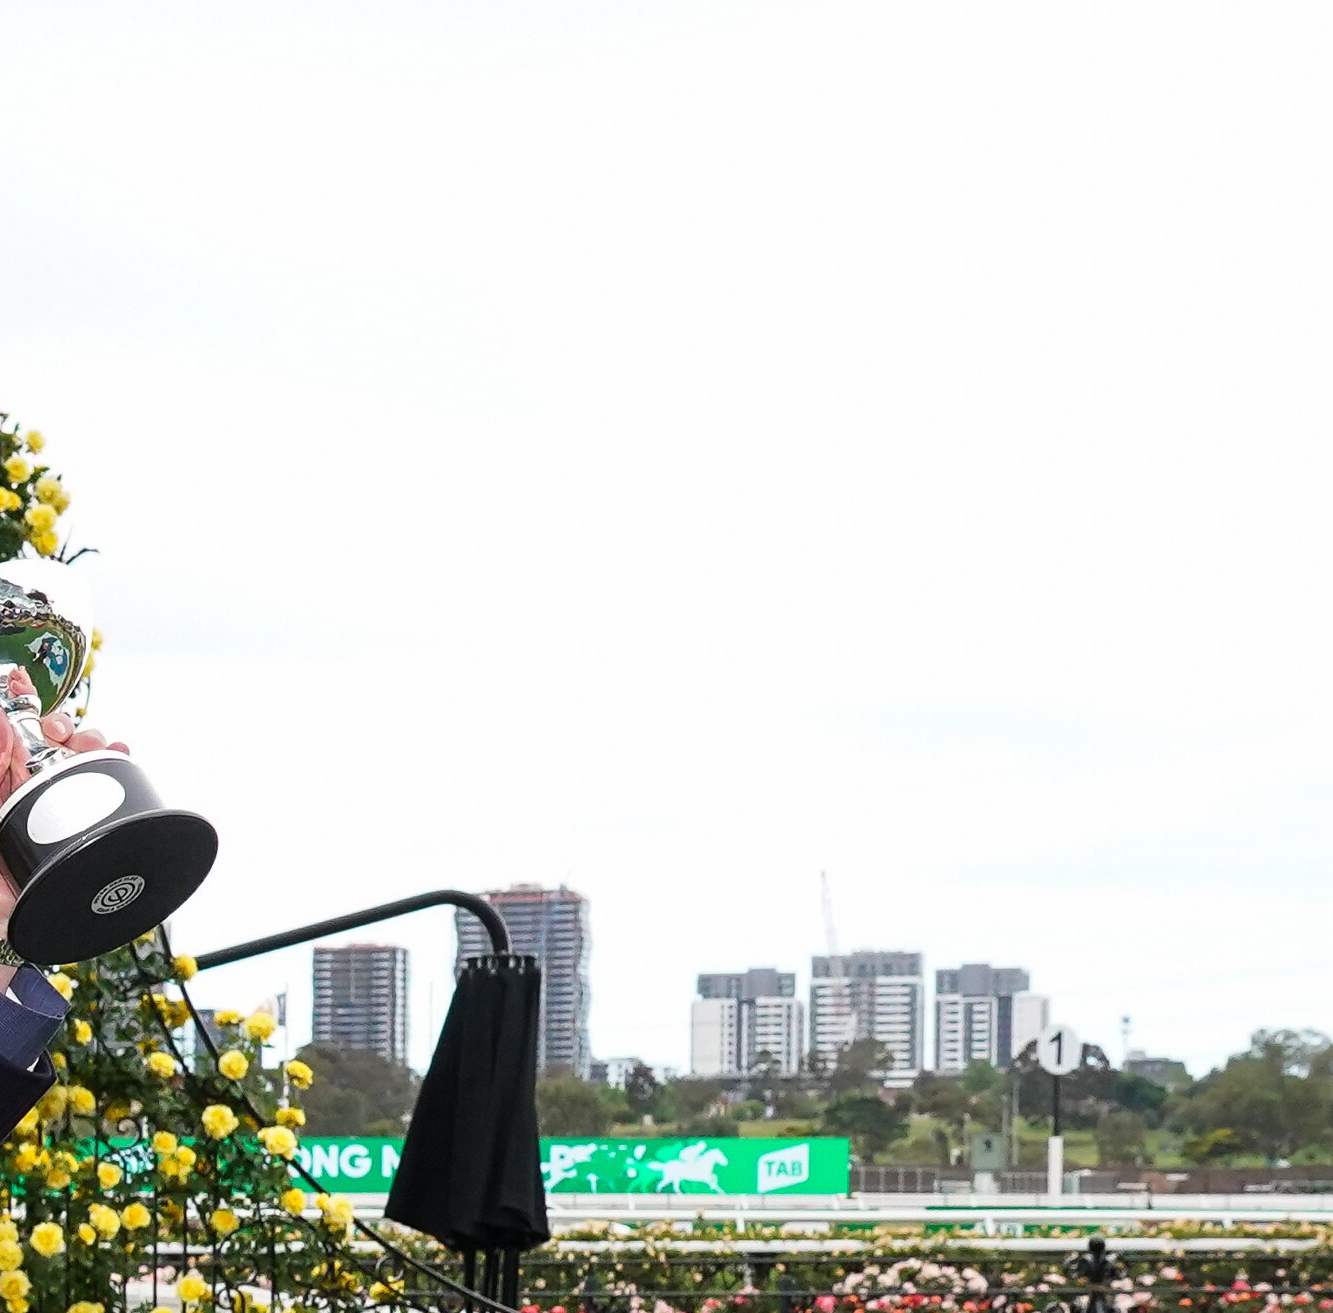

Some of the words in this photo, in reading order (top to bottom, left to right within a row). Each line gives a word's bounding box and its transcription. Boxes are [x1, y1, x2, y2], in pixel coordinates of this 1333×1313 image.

[1048, 1032, 1063, 1065] 1
[286, 1144, 373, 1178] ONG
[765, 1160, 803, 1177] TAB
